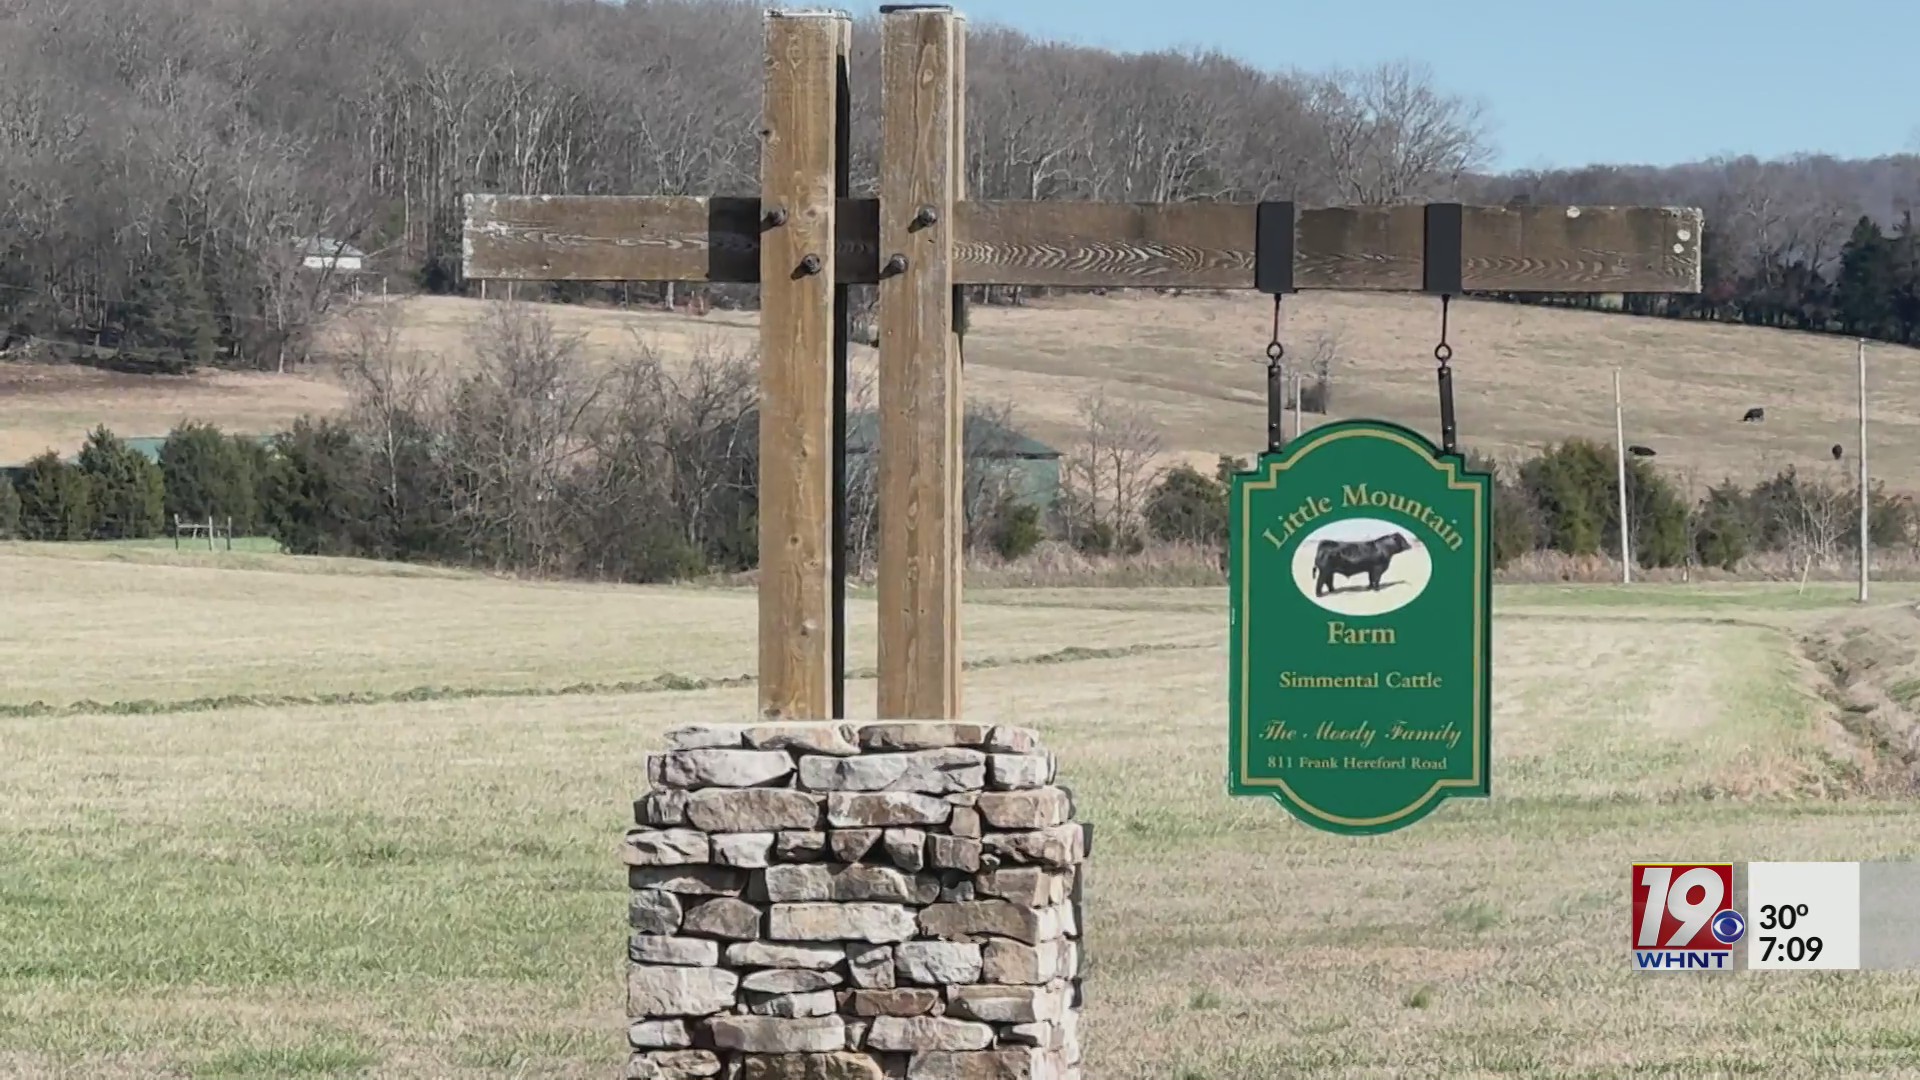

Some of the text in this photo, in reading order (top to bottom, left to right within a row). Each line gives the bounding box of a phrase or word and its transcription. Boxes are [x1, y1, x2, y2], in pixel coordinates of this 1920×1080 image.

[1262, 483, 1464, 551] Little Mountain
[1327, 621, 1397, 644] Farm
[1279, 671, 1443, 688] Simmental Cattle
[1259, 719, 1462, 749] The Moody Family
[1267, 756, 1447, 769] 811 Frank Hereford Road
